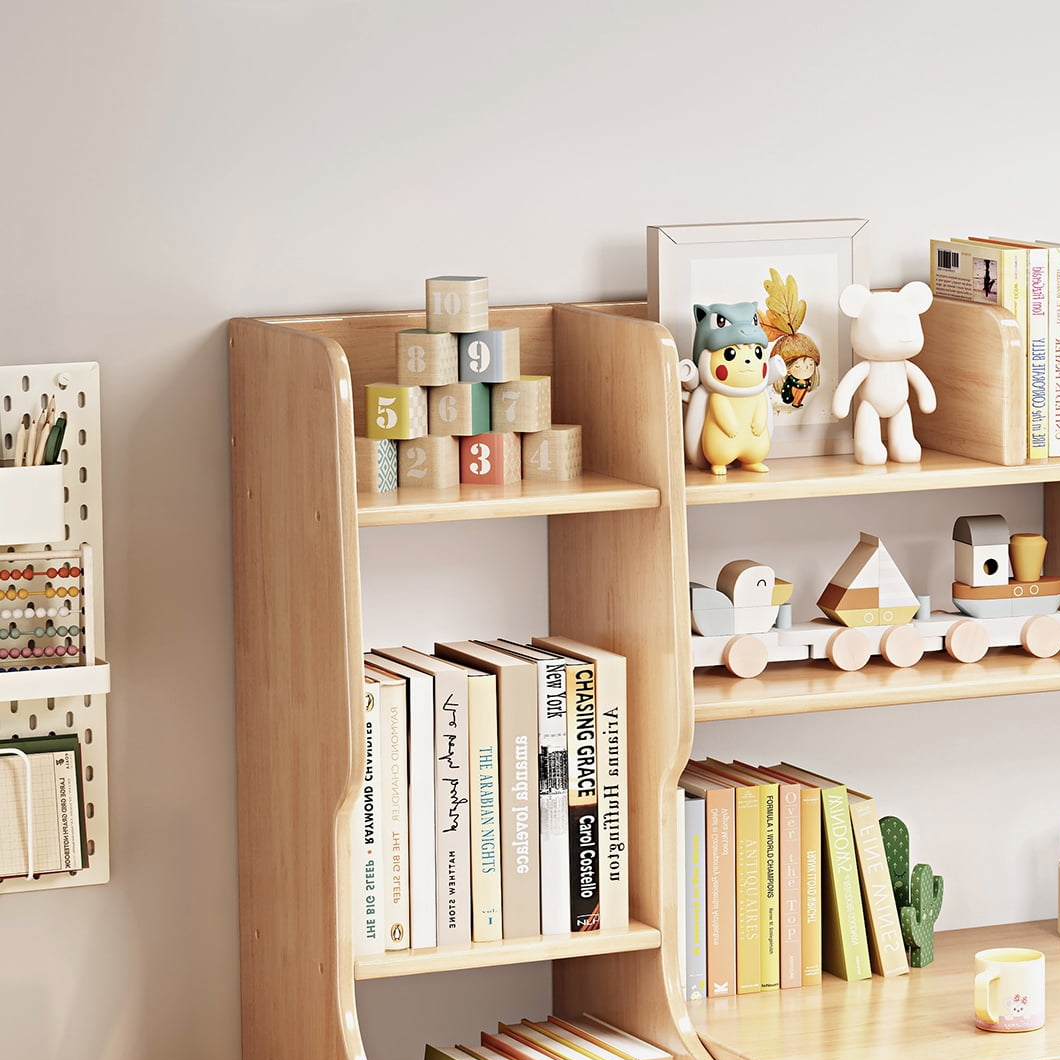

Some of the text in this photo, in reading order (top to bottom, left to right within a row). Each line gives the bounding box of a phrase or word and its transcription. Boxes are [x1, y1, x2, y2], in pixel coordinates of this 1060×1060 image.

[431, 291, 460, 316] 10
[407, 345, 425, 373] 8
[468, 340, 490, 373] 9
[376, 396, 397, 429] 5
[438, 395, 458, 422] 6
[502, 391, 520, 422] 7
[407, 447, 427, 478] 2
[469, 443, 491, 475] 3
[530, 440, 552, 470] 4
[546, 664, 567, 719] New York
[575, 669, 596, 798] CHASING GRACE
[479, 745, 496, 874] THE ARABIAN NIGHTS
[579, 815, 596, 847] Carol
[580, 849, 597, 898] Costello
[744, 839, 758, 941] ANTIQUAIRES
